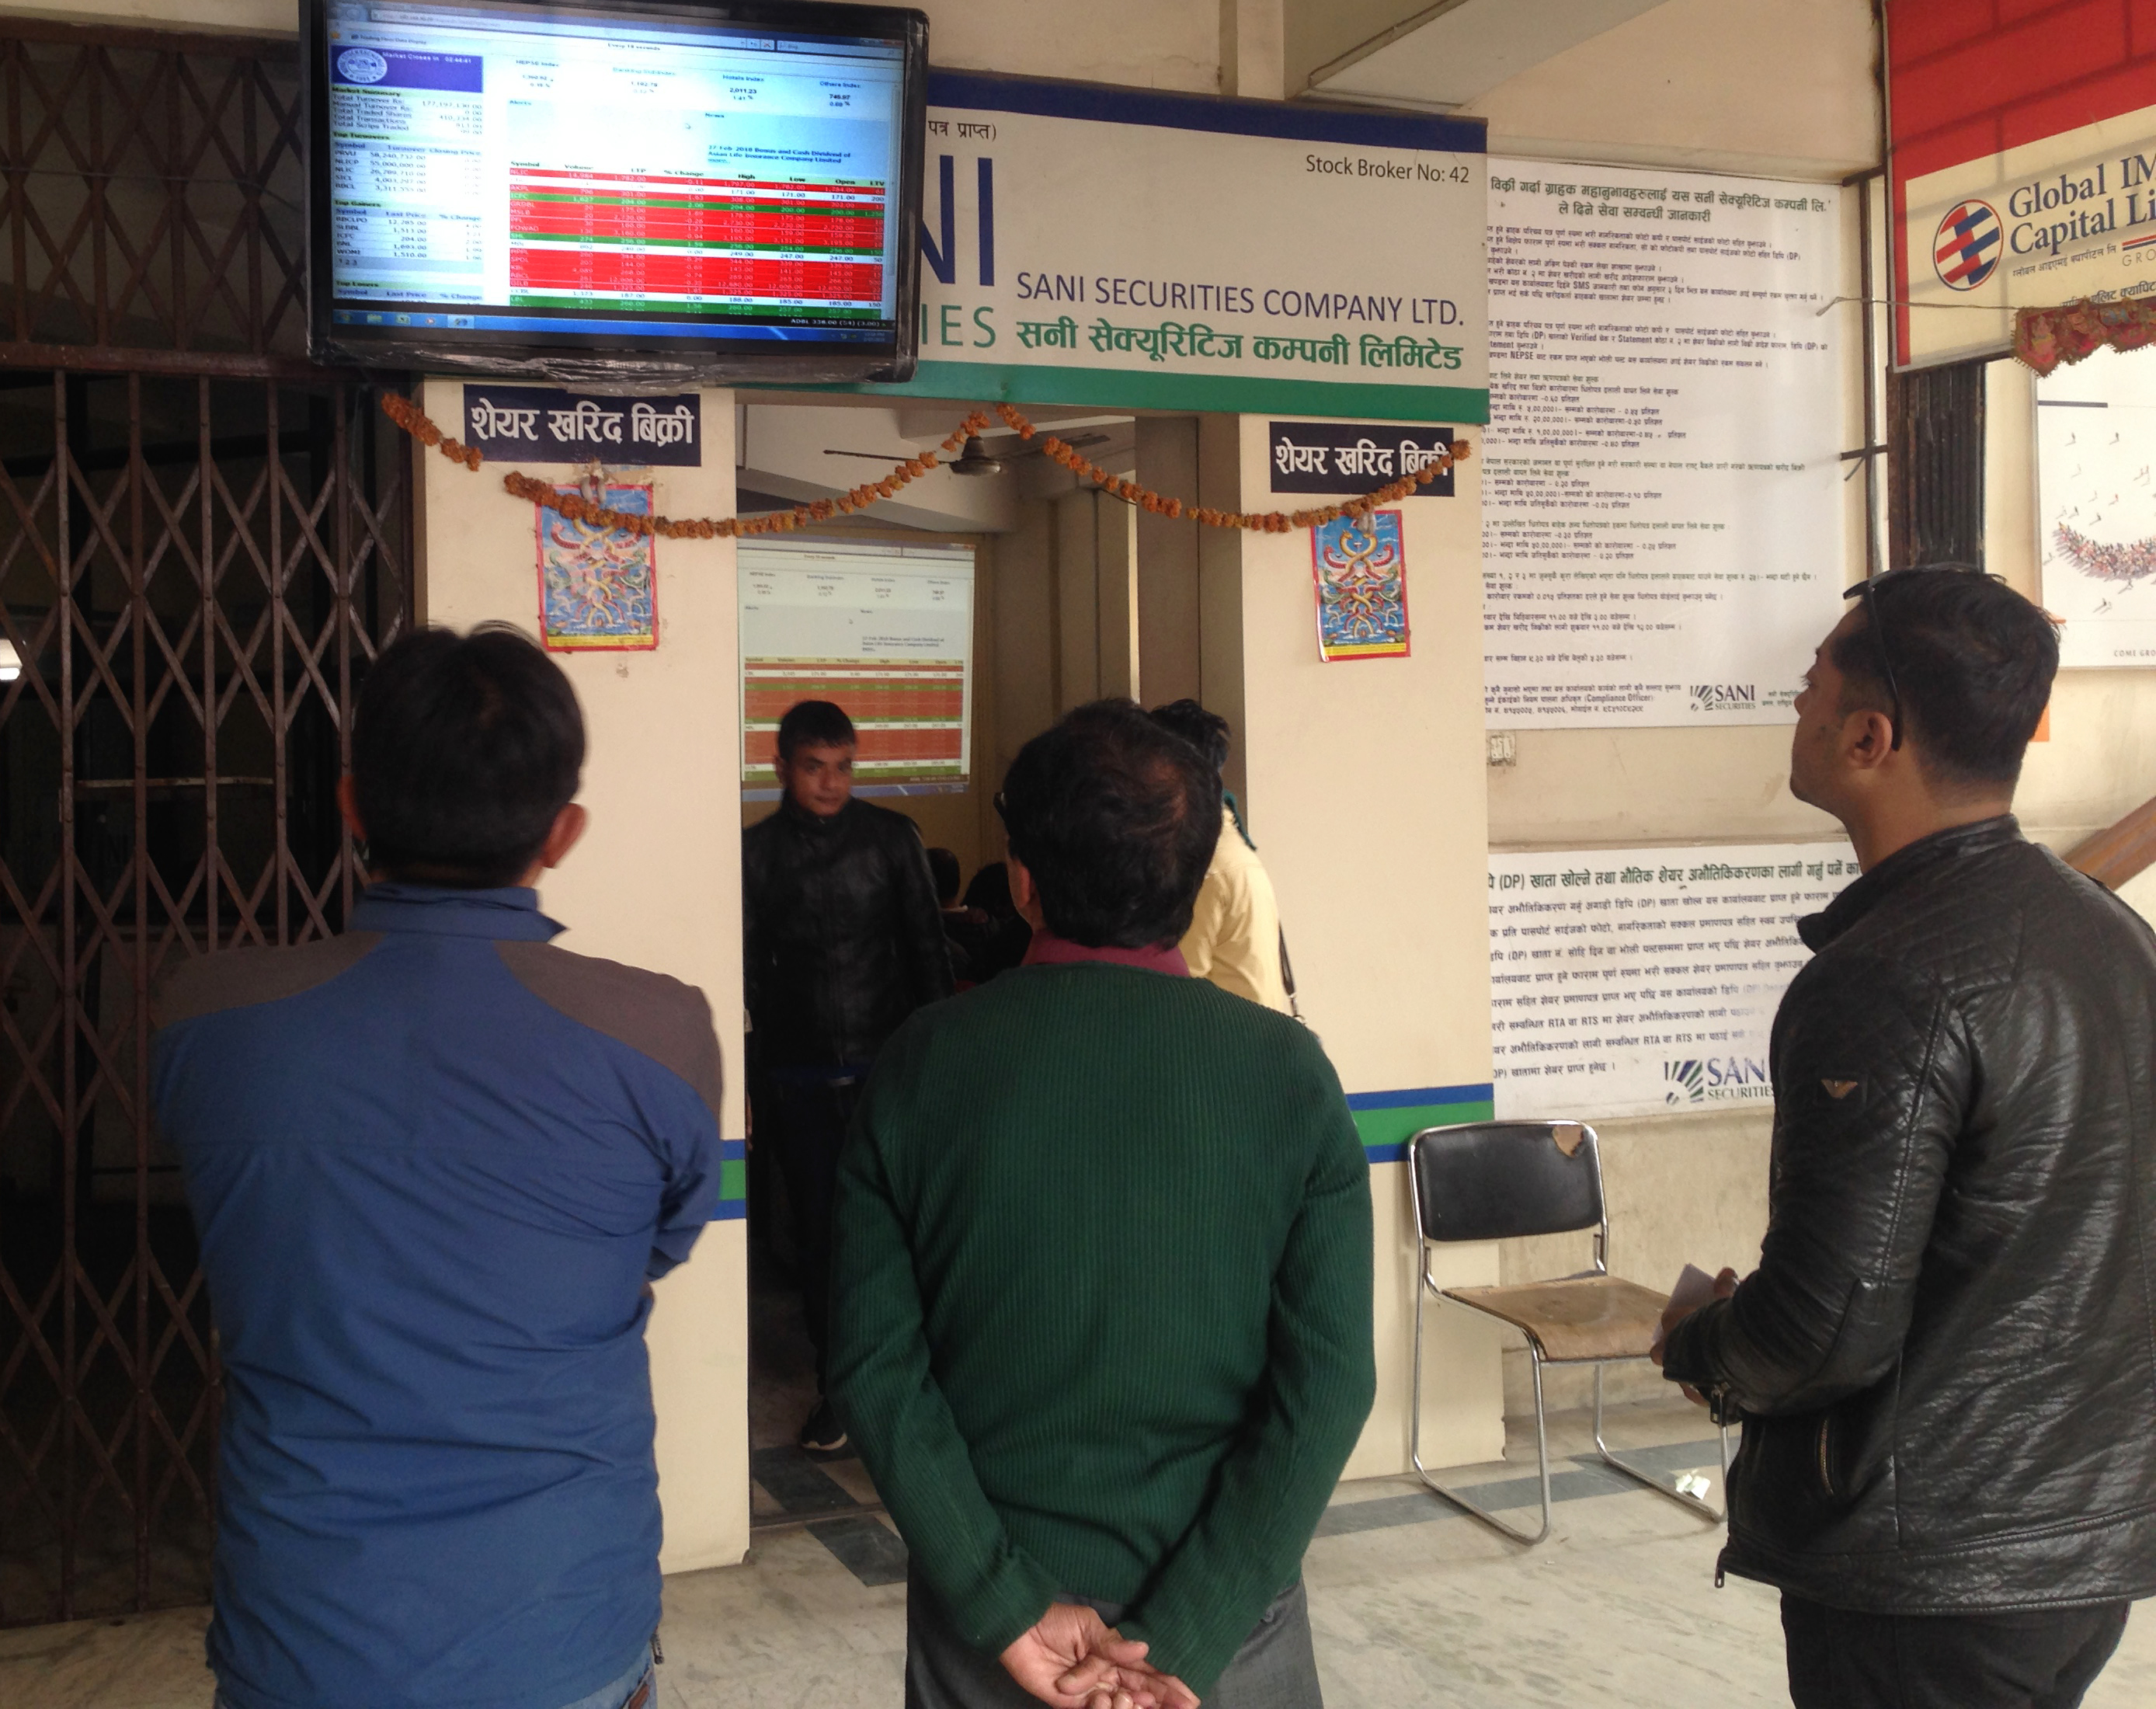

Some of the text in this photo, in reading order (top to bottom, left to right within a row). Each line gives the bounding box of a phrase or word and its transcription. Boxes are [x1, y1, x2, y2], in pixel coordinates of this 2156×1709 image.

[928, 120, 949, 137] पत्र
[1306, 155, 1469, 183] Stock Broker No: 42
[2008, 163, 2106, 218] Global
[2010, 198, 2116, 256] Capital
[1574, 281, 1590, 290] SMS
[1018, 272, 1464, 325] SANI SECURITIES COMPANY LTD.
[1017, 317, 1463, 369] सनी सेक्यूरिटिज कम्पनी लिमिटेड
[1619, 335, 1652, 343] Statement
[1511, 351, 1533, 360] NEPSE
[472, 398, 694, 447] शेयर खरिद बिक्री
[1275, 437, 1329, 475] शेयर
[1335, 438, 1394, 477] खरिद
[1715, 684, 1754, 701] SANI
[1715, 701, 1755, 710] SECURITIES
[1500, 874, 1525, 890] (DP)
[1549, 1018, 1565, 1027] RTA
[1582, 1016, 1598, 1025] RTS
[1644, 1036, 1660, 1045] RTA
[1676, 1034, 1692, 1043] RTS
[1708, 1056, 1772, 1086] SAN
